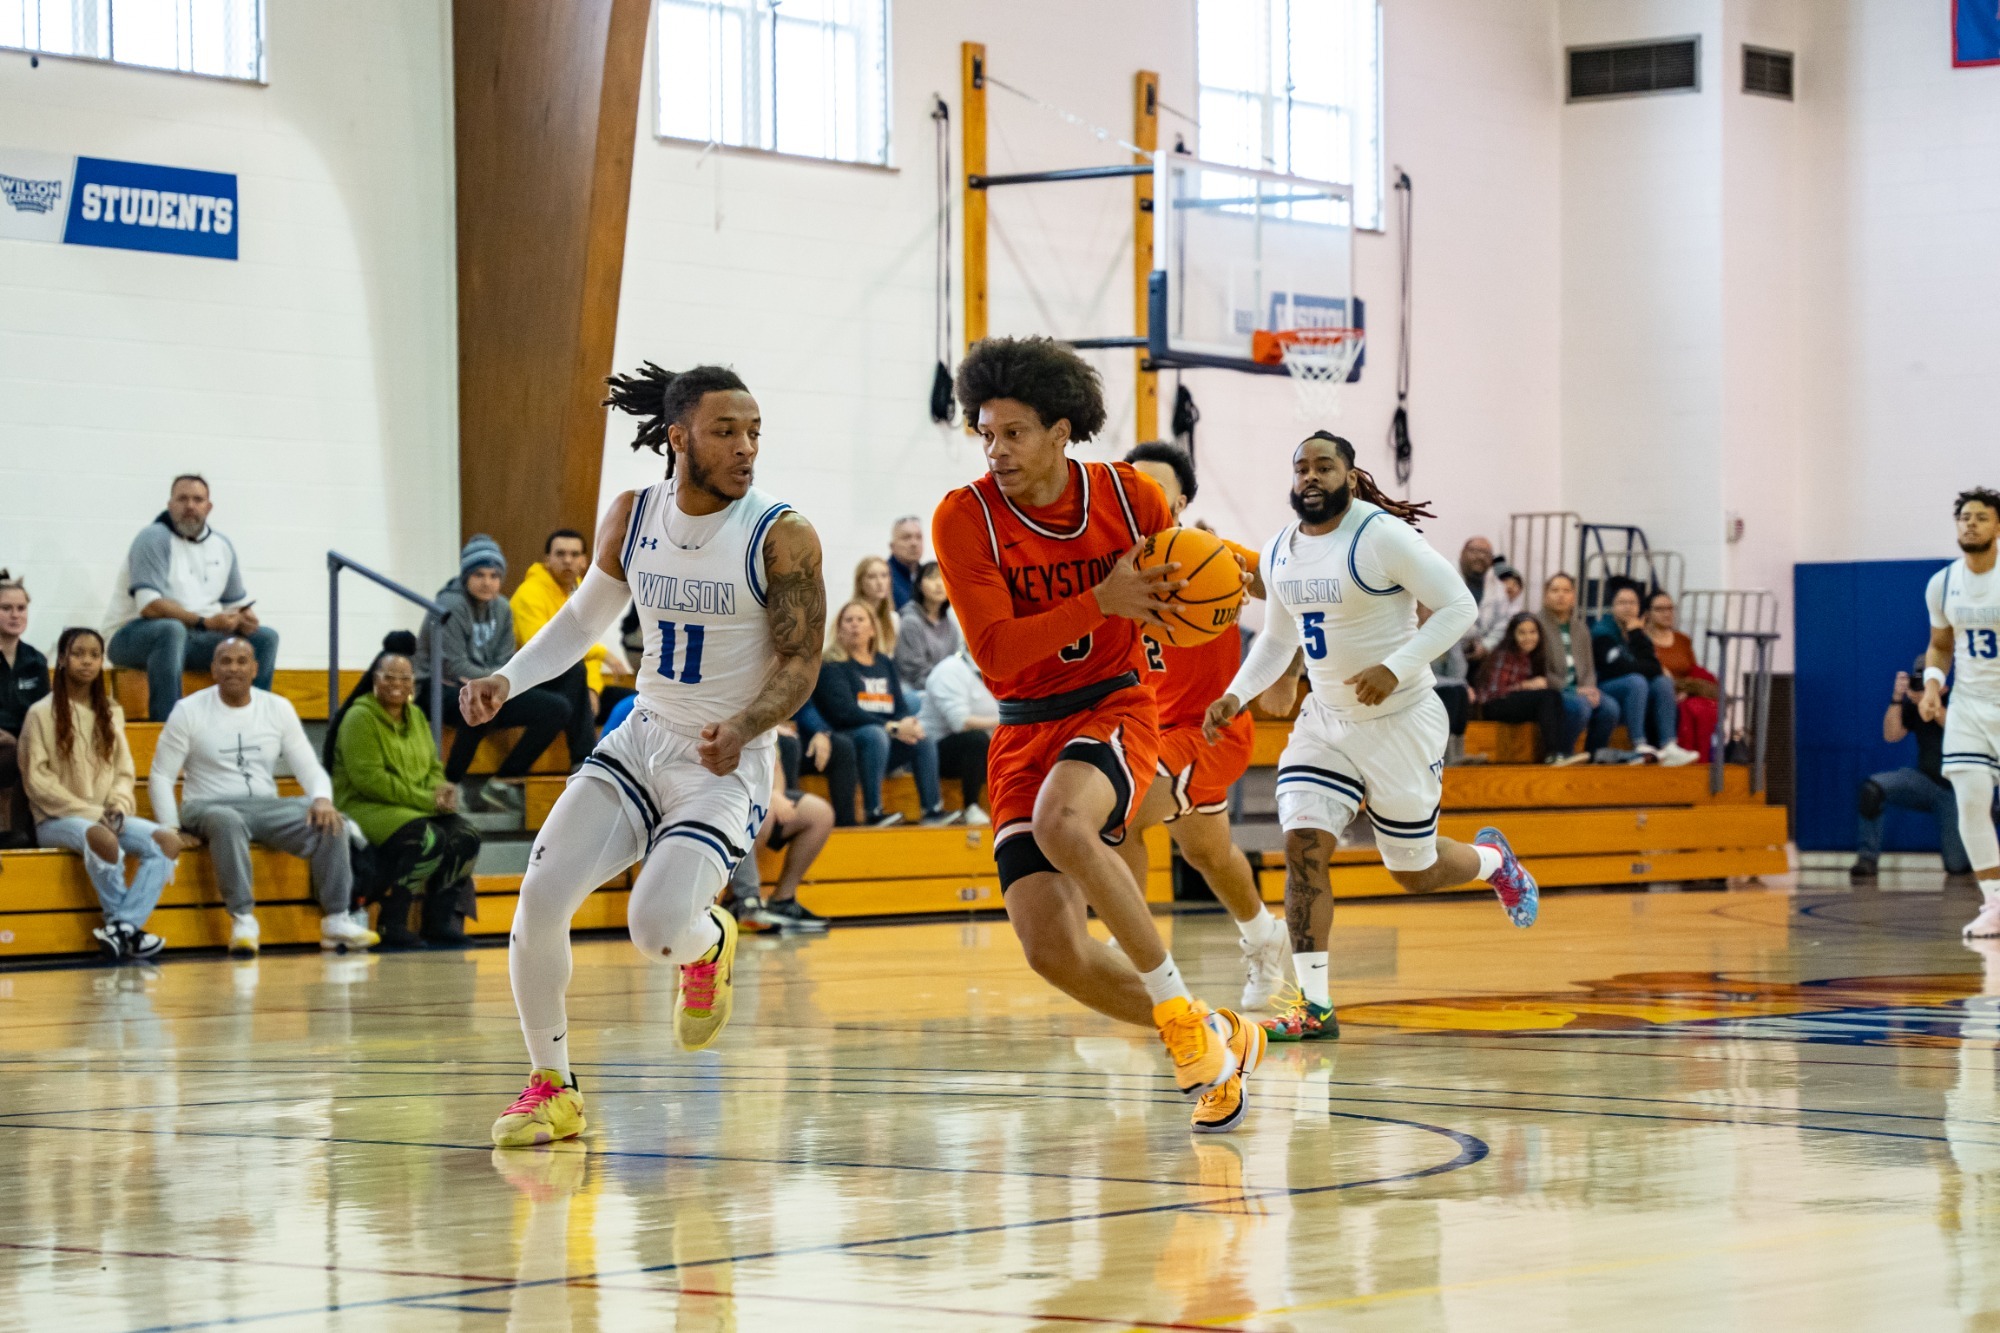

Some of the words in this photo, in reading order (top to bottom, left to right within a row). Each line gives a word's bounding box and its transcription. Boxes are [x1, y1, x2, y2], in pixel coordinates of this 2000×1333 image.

[0, 175, 61, 200] WILSON
[82, 183, 233, 235] STUDENTS
[638, 571, 736, 615] WILSON
[1277, 578, 1343, 606] WILSON
[657, 620, 705, 684] 11
[1142, 633, 1167, 672] 2
[1301, 611, 1328, 660] 5
[1965, 629, 1998, 660] 13
